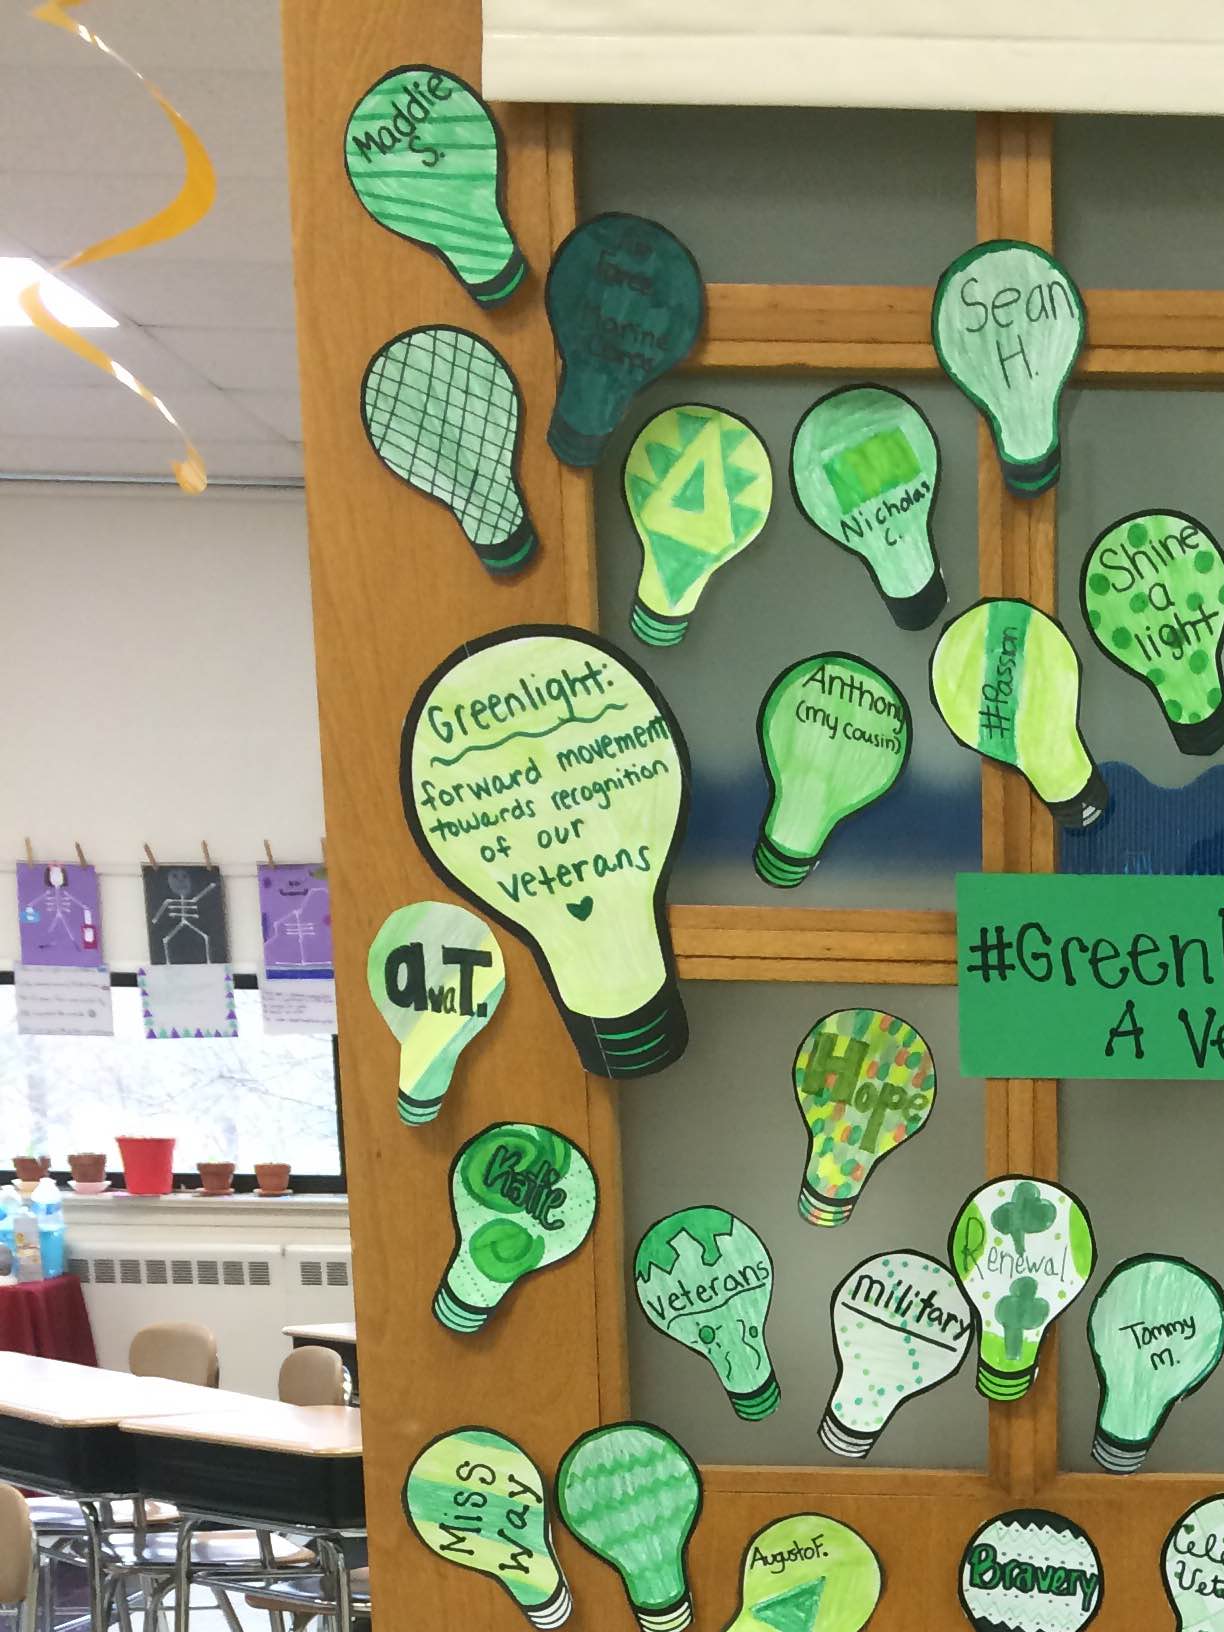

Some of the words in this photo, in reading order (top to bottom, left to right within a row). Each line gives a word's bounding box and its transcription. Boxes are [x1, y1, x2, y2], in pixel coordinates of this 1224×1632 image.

[352, 71, 452, 164] Maddie
[408, 135, 446, 168] S.
[959, 277, 1075, 333] Sean
[996, 335, 1040, 389] H.
[839, 480, 931, 544] Nicholas
[884, 524, 905, 546] C.
[1099, 524, 1201, 593] Shine
[1148, 581, 1175, 611] a
[1134, 602, 1220, 662] light
[428, 660, 615, 744] Greenlight:
[795, 699, 840, 742] (my
[802, 663, 907, 734] Anthony
[420, 757, 542, 811] forward
[429, 800, 536, 841] towards
[551, 759, 669, 809] recognition
[480, 836, 512, 863] of
[537, 818, 585, 849] our
[1105, 1000, 1145, 1059] A
[966, 1541, 1100, 1614] Bravery
